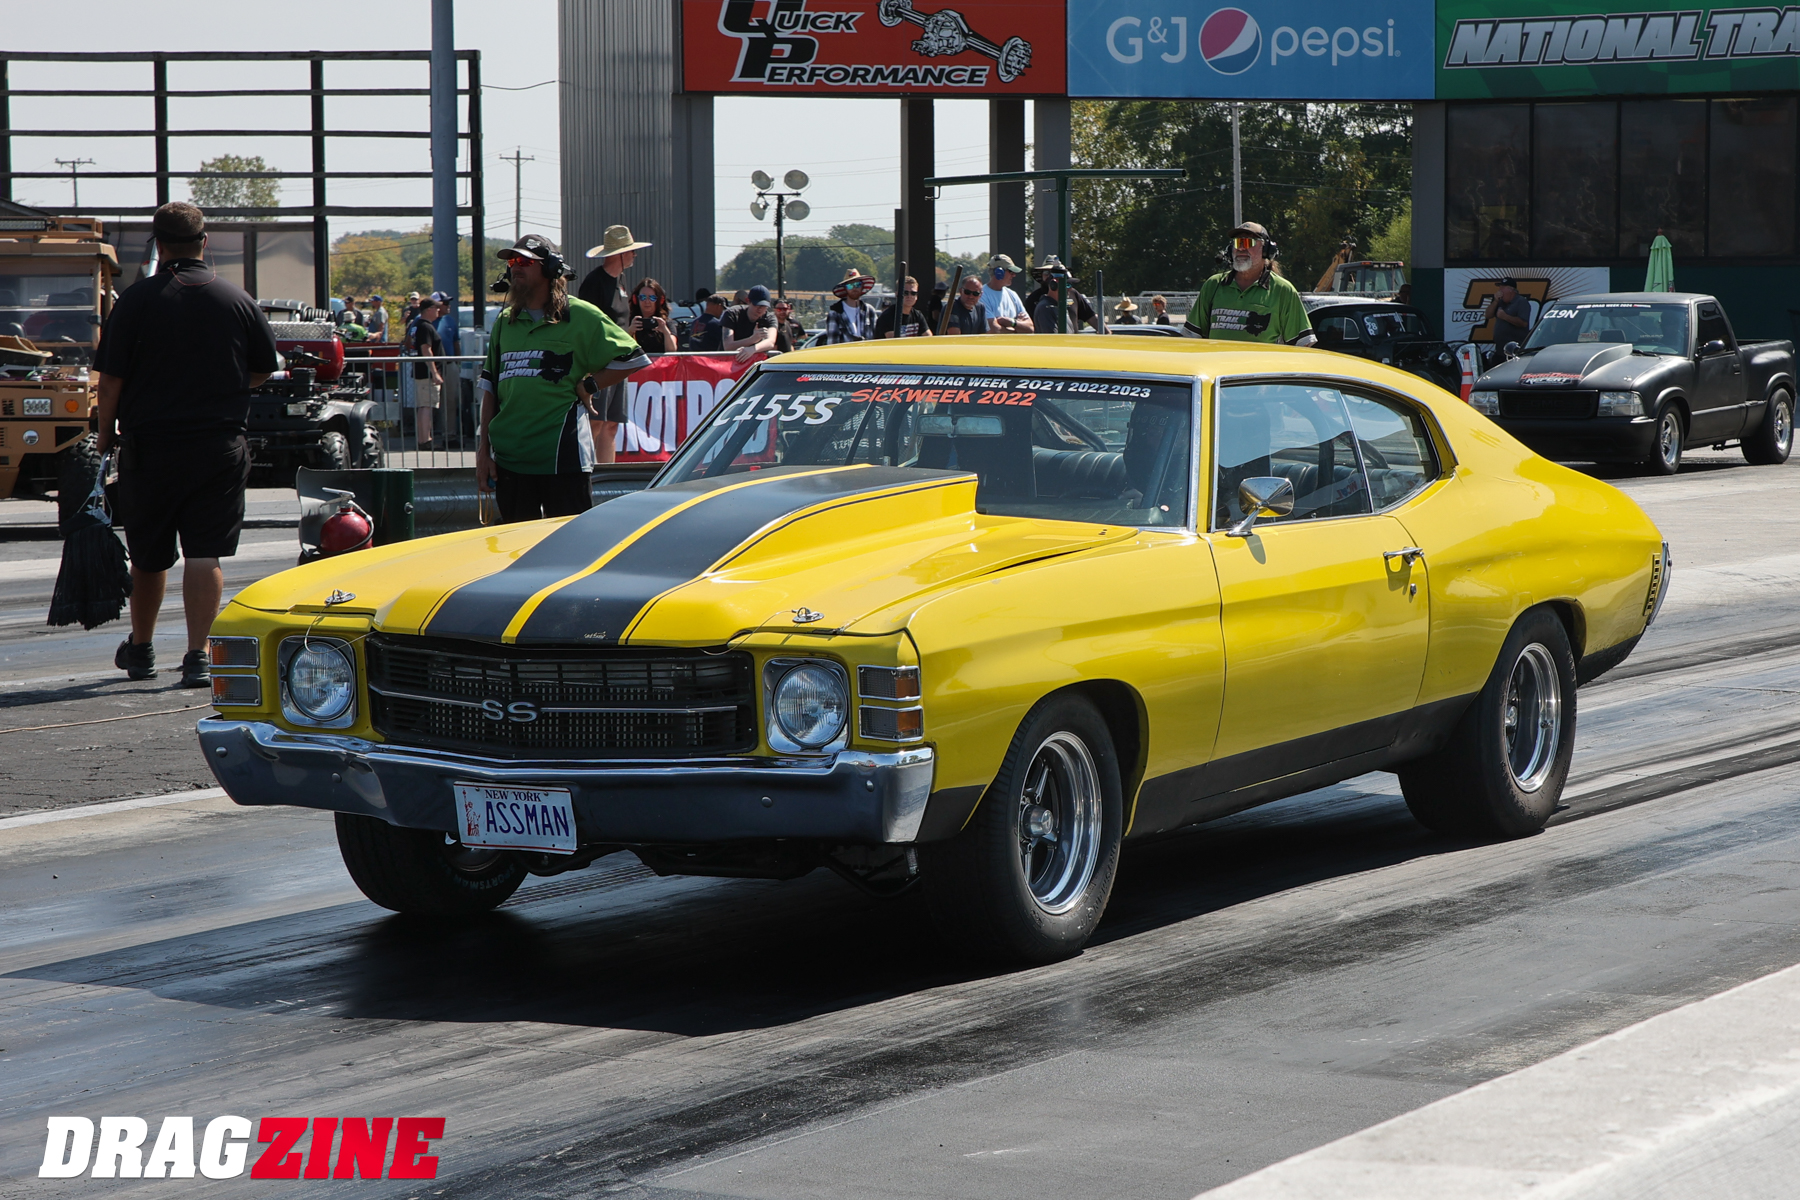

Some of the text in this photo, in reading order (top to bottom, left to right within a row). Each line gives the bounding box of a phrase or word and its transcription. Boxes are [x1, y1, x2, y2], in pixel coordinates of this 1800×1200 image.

[1106, 16, 1395, 66] G&J pepsi
[1445, 11, 1703, 69] NATIONAL
[730, 35, 990, 86] PERFORMANCE
[1211, 309, 1250, 317] NATIONAL
[1452, 311, 1485, 322] WCLT
[1543, 310, 1579, 319] C19N
[501, 351, 543, 361] NATIONAL
[504, 360, 529, 369] TRAIL
[498, 369, 541, 381] RACEWAY
[843, 374, 879, 384] 2024
[876, 375, 900, 385] HOT
[924, 376, 963, 387] DRAG
[968, 378, 1011, 389] WEEK
[1015, 379, 1064, 392] 2021
[1068, 382, 1107, 395] 2022
[1109, 385, 1151, 398] 2023
[977, 391, 1037, 406] 2022
[713, 394, 842, 426] C155S
[482, 699, 538, 722] SS
[485, 790, 541, 802] NEW YORK
[485, 801, 570, 837] ASSMAN
